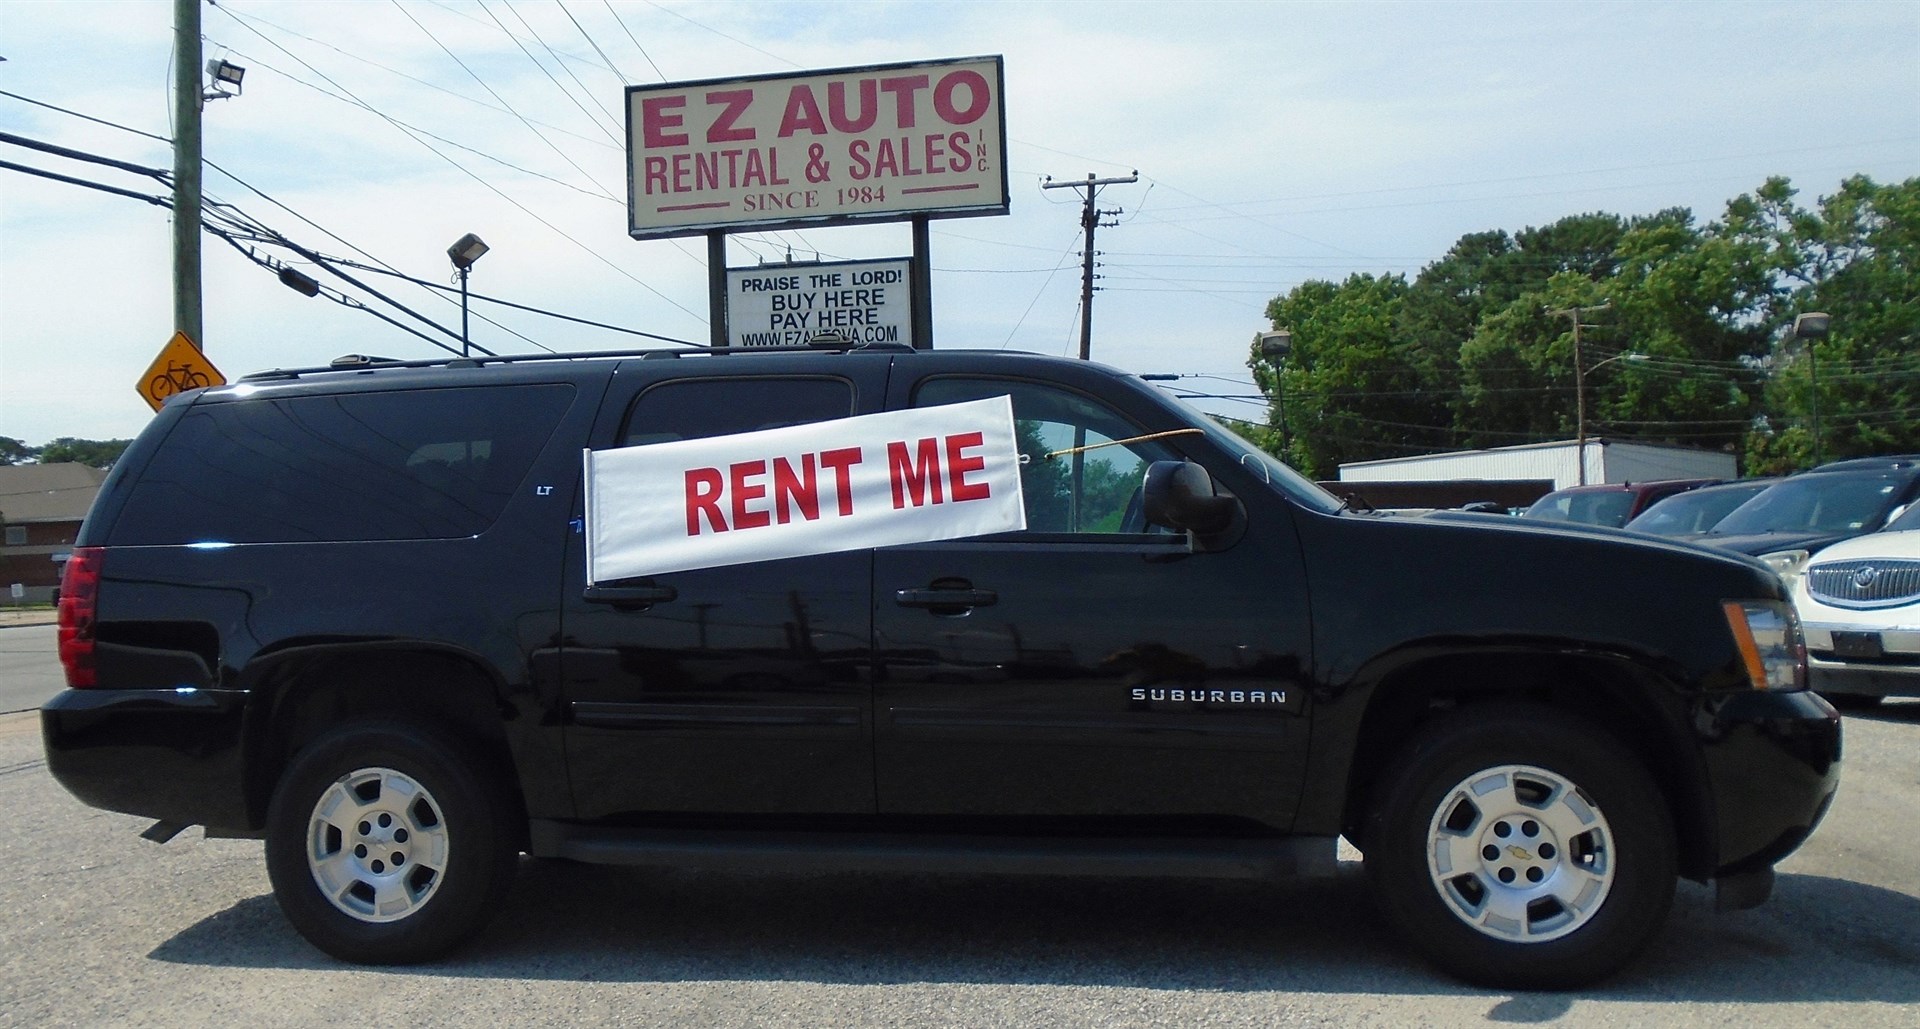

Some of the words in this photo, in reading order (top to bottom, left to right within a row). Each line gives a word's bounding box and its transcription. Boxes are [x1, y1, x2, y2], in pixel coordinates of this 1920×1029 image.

[777, 69, 991, 138] AUTO
[645, 146, 790, 195] RENTAL
[804, 142, 831, 184] &
[848, 131, 972, 180] SALES
[743, 190, 820, 212] SINCE
[837, 185, 886, 206] 1984
[741, 276, 800, 293] PRAISE
[809, 273, 842, 289] THE
[852, 269, 902, 285] LORD!
[771, 292, 817, 312] BUY
[824, 288, 885, 309] HERE
[770, 311, 811, 330] PAY
[818, 307, 879, 328] HERE
[536, 485, 554, 496] LT
[683, 446, 863, 537] RENT
[886, 431, 991, 510] ME
[1132, 688, 1286, 703] SUBURBAN
